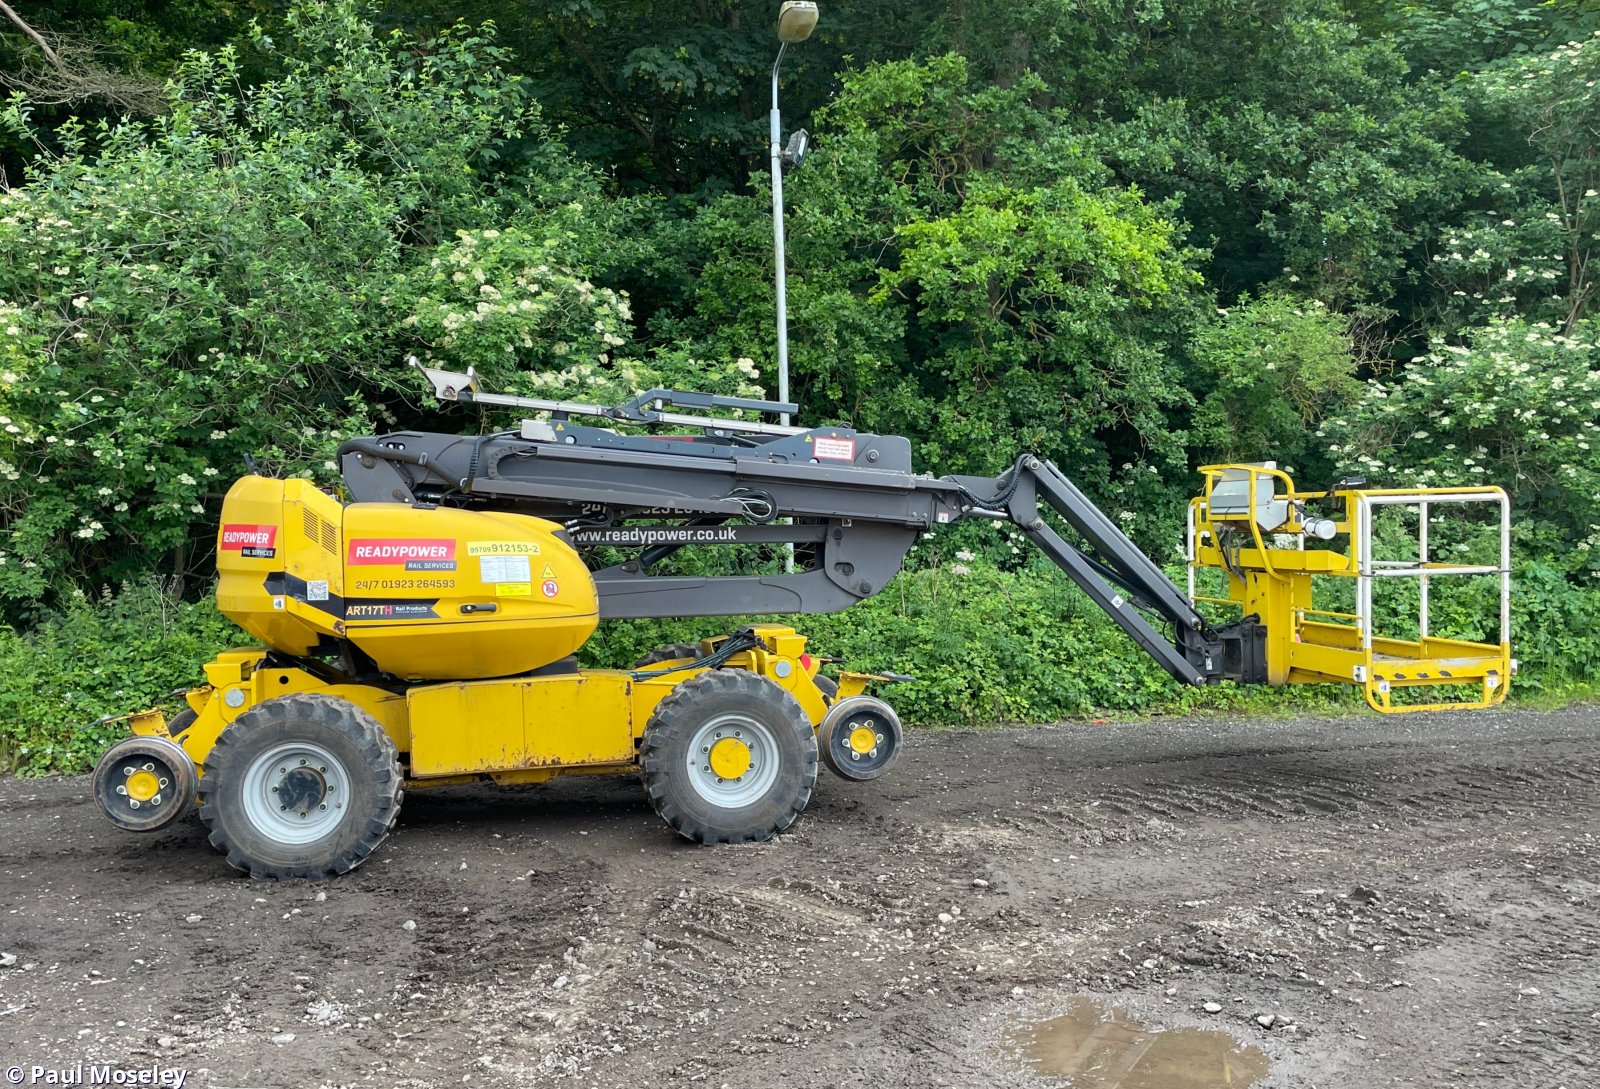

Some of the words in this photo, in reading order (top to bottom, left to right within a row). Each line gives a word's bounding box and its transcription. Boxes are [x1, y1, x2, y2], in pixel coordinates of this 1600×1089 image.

[223, 531, 269, 544] READYPOWER
[571, 527, 737, 544] ww.readypower.co.uk
[251, 548, 274, 557] SERVICES
[356, 546, 448, 558] READYPOWER
[355, 580, 379, 591] 24/7
[381, 580, 414, 589] 01923
[416, 579, 456, 589] 264593
[346, 605, 393, 616] ART17TH
